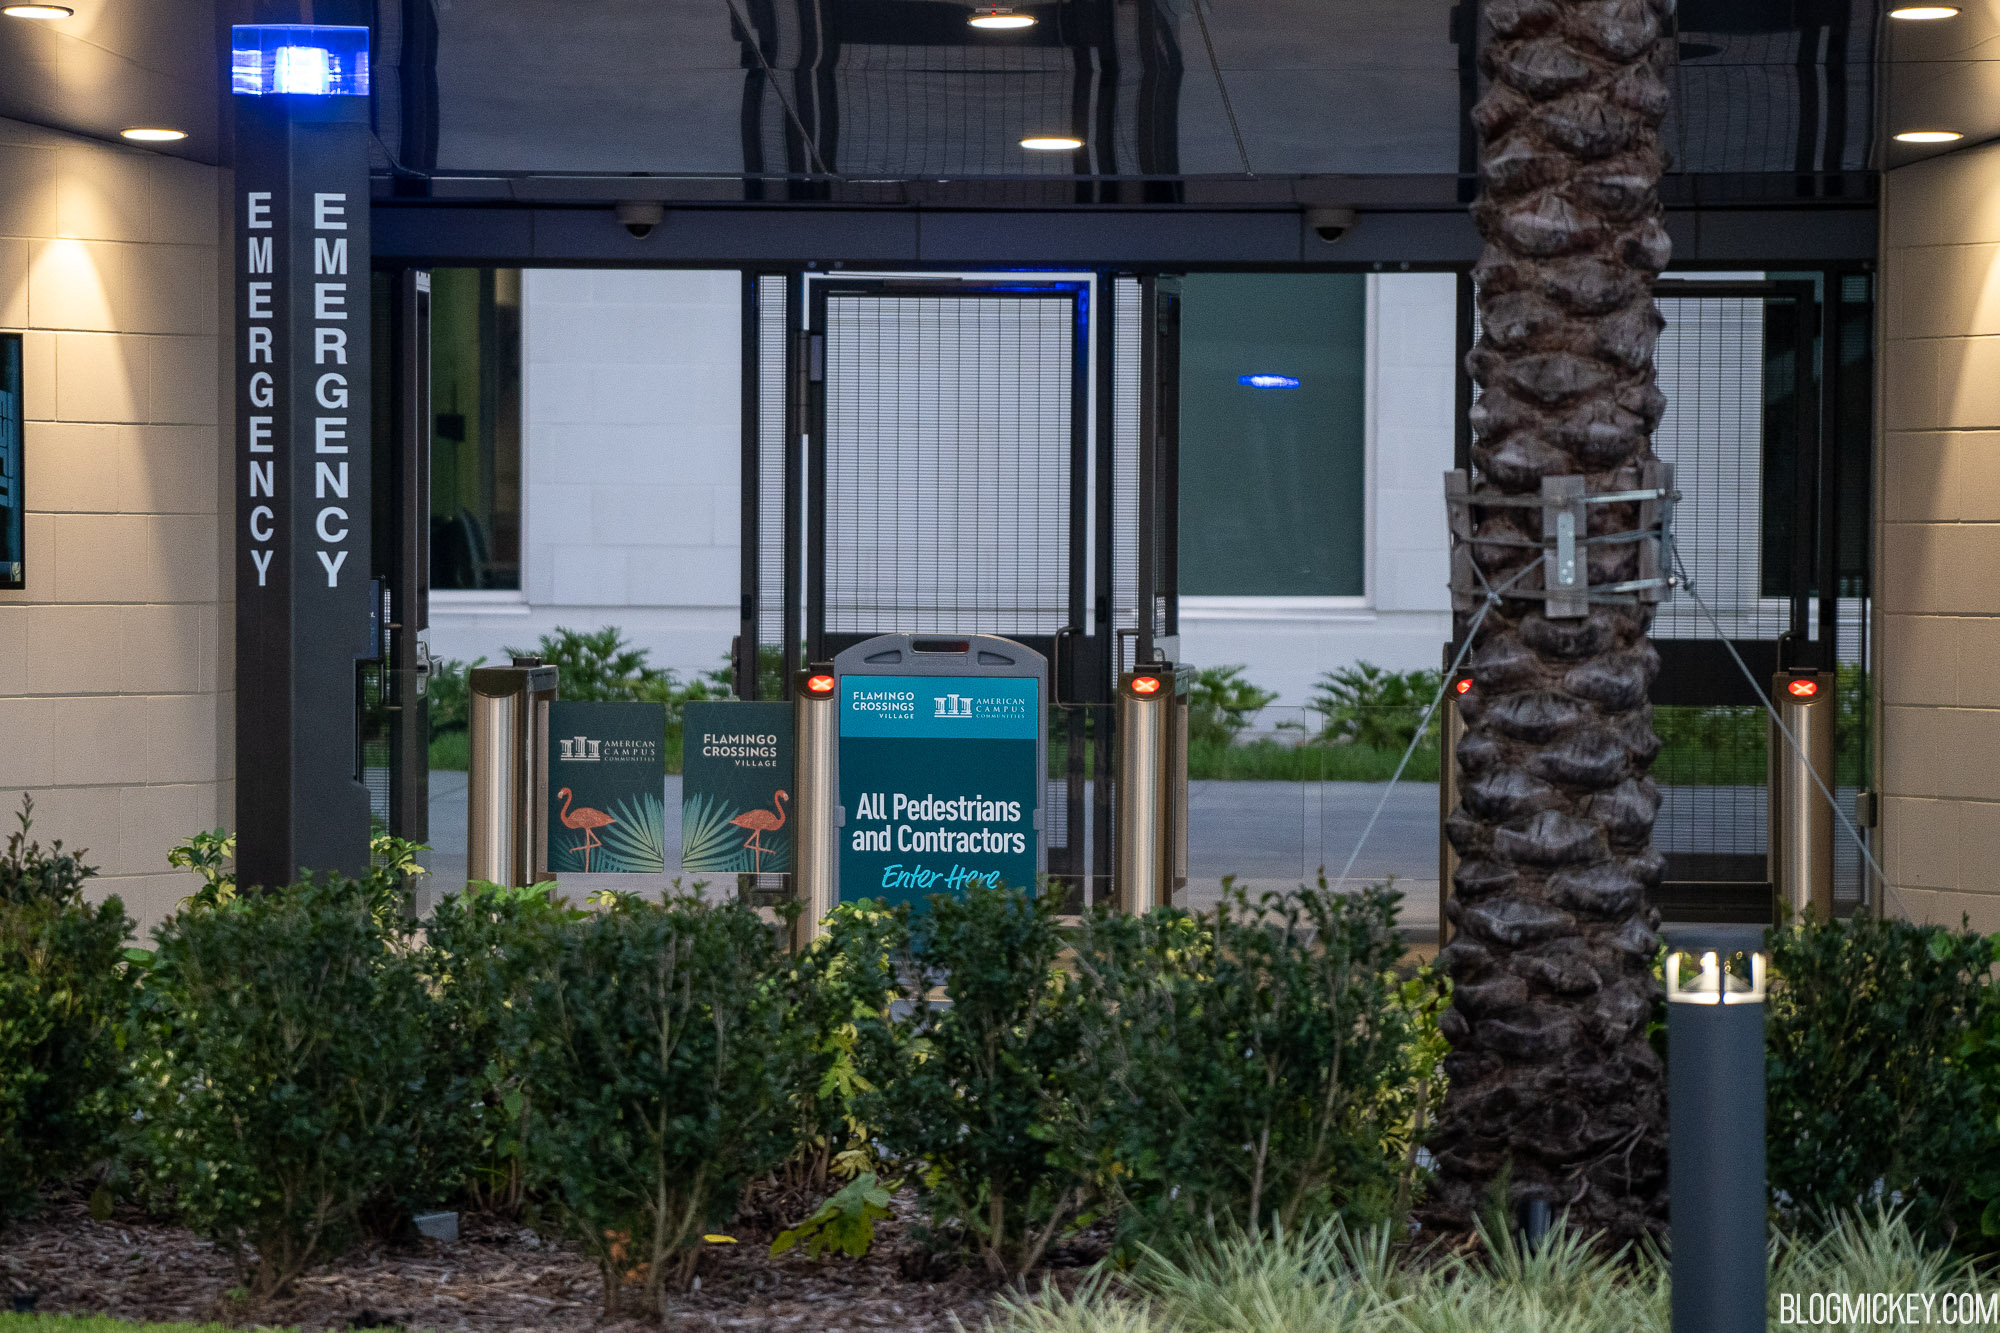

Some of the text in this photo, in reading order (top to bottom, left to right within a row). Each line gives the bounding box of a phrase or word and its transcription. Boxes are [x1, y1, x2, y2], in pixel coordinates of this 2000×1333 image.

[247, 192, 275, 587] EMERGENCY
[314, 192, 350, 588] EMERGENCY
[853, 691, 915, 701] FLAMINGO
[976, 697, 1025, 705] AMERICAN
[852, 701, 915, 711] CROSSINGS
[976, 705, 1025, 713] CAMPUS
[604, 740, 656, 748] AMERICAN
[703, 733, 777, 745] FLAMINGO
[604, 748, 656, 756] CAMPUS
[702, 745, 777, 758] CROSSINGS
[734, 759, 777, 767] VILLAGE
[856, 792, 1021, 822] All Pedestrians
[852, 824, 1026, 854] and Contractors
[881, 863, 944, 889] Enter
